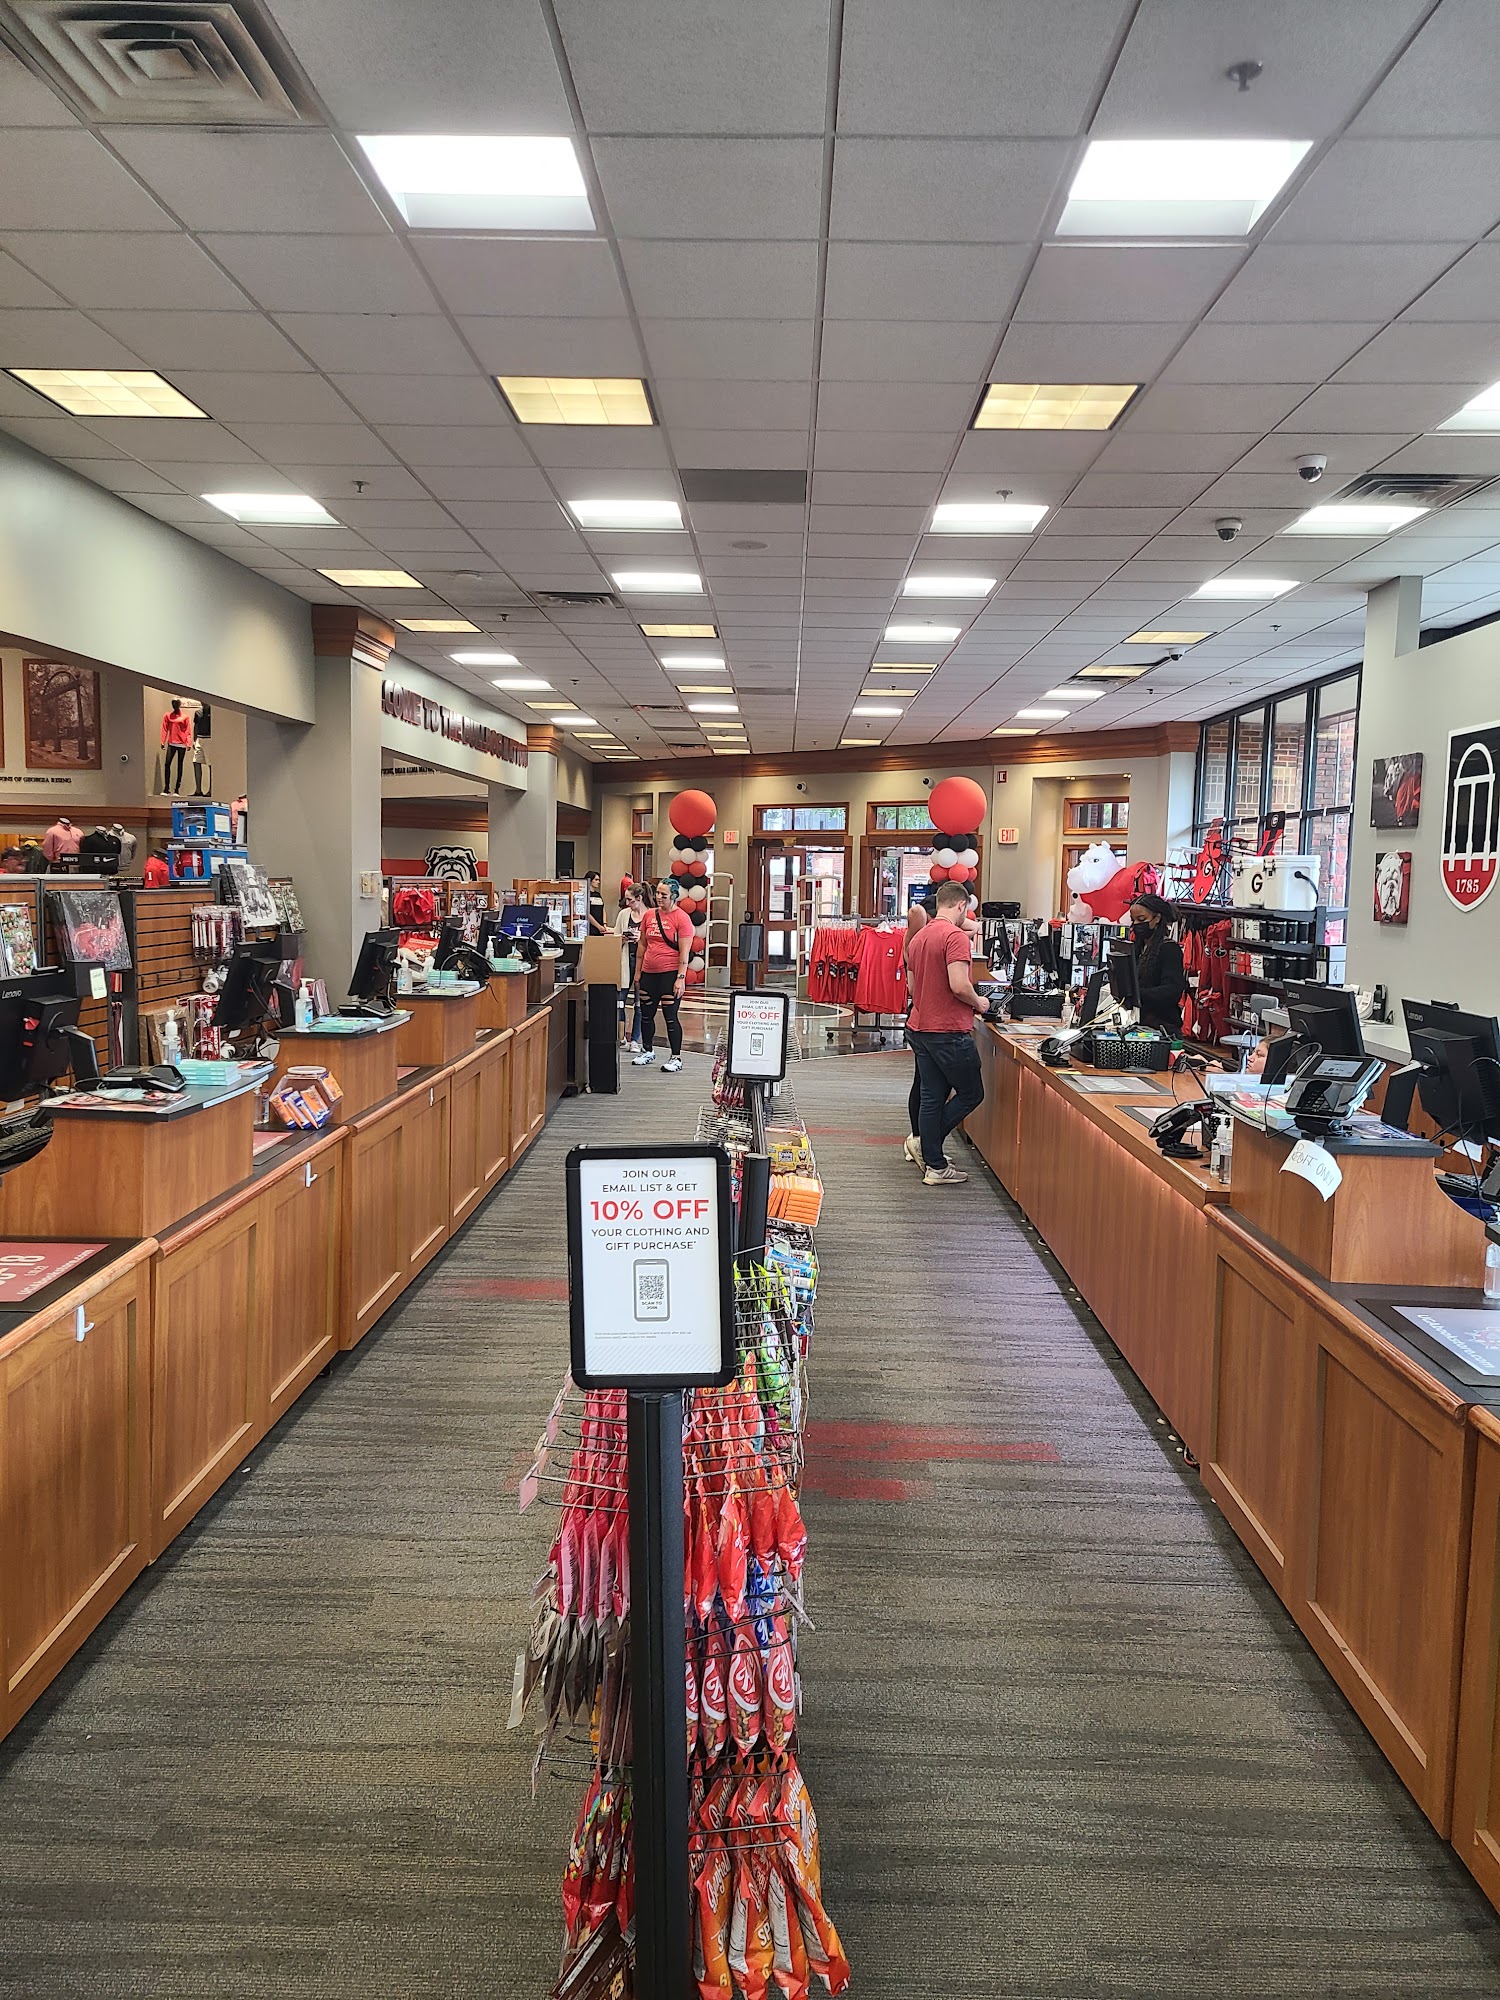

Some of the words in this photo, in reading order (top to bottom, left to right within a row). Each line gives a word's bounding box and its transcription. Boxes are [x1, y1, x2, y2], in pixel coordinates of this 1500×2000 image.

[382, 680, 422, 727] COME
[422, 697, 440, 733] TO
[440, 705, 463, 745] THE
[1002, 829, 1015, 842] EXIT
[1252, 874, 1263, 893] G
[1455, 878, 1479, 894] 1785
[737, 1010, 756, 1019] 10%
[1406, 1010, 1424, 1022] Lenovo
[622, 1170, 648, 1178] JOIN
[652, 1170, 676, 1178] OUR
[602, 1184, 636, 1192] EMAIL
[640, 1184, 662, 1192] LIST
[665, 1184, 673, 1192] &
[676, 1183, 697, 1191] GET
[590, 1200, 643, 1220] 10%
[653, 1200, 710, 1220] OFF
[591, 1229, 622, 1237] YOUR
[625, 1228, 682, 1236] CLOTHING
[685, 1227, 710, 1236] AND
[606, 1242, 630, 1250] GIFT
